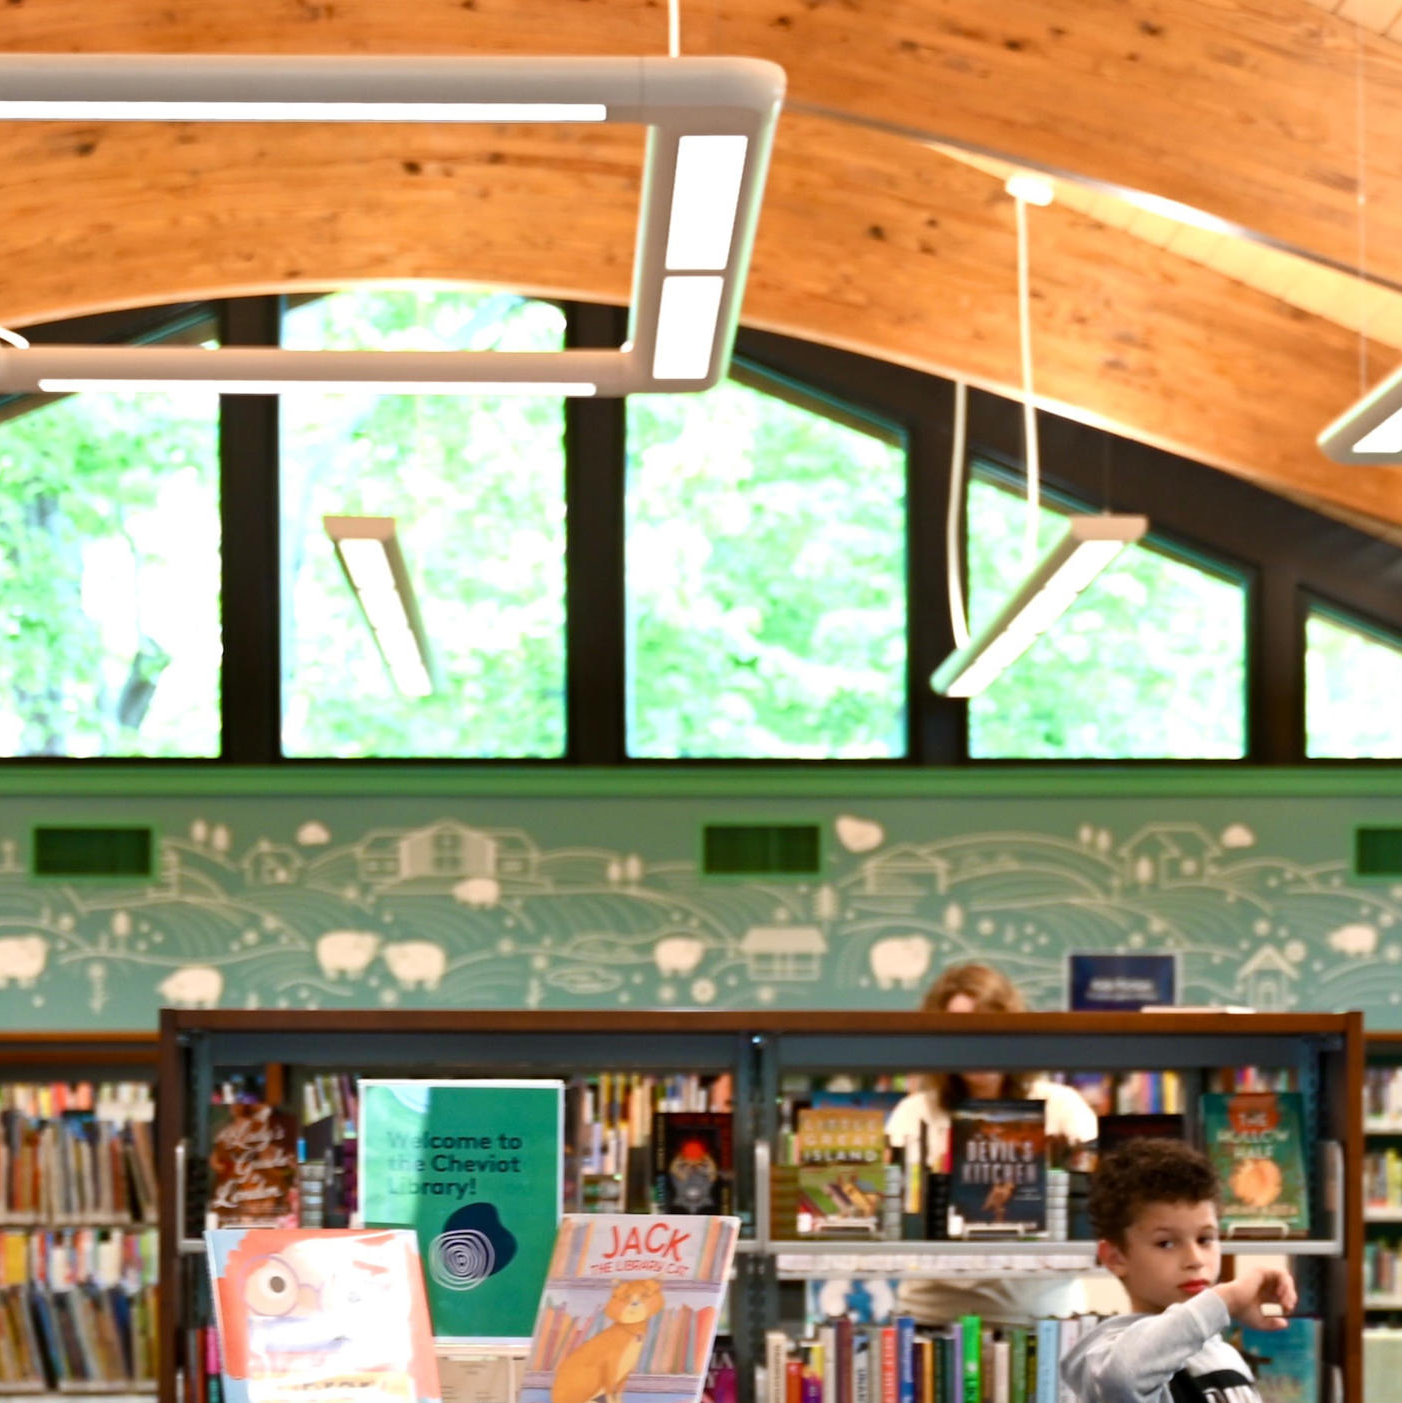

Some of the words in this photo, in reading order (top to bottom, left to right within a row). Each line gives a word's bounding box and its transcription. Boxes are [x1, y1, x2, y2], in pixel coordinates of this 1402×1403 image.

[498, 1133, 523, 1150] to
[431, 1154, 522, 1173] Cheviot
[602, 1222, 691, 1262] JACK
